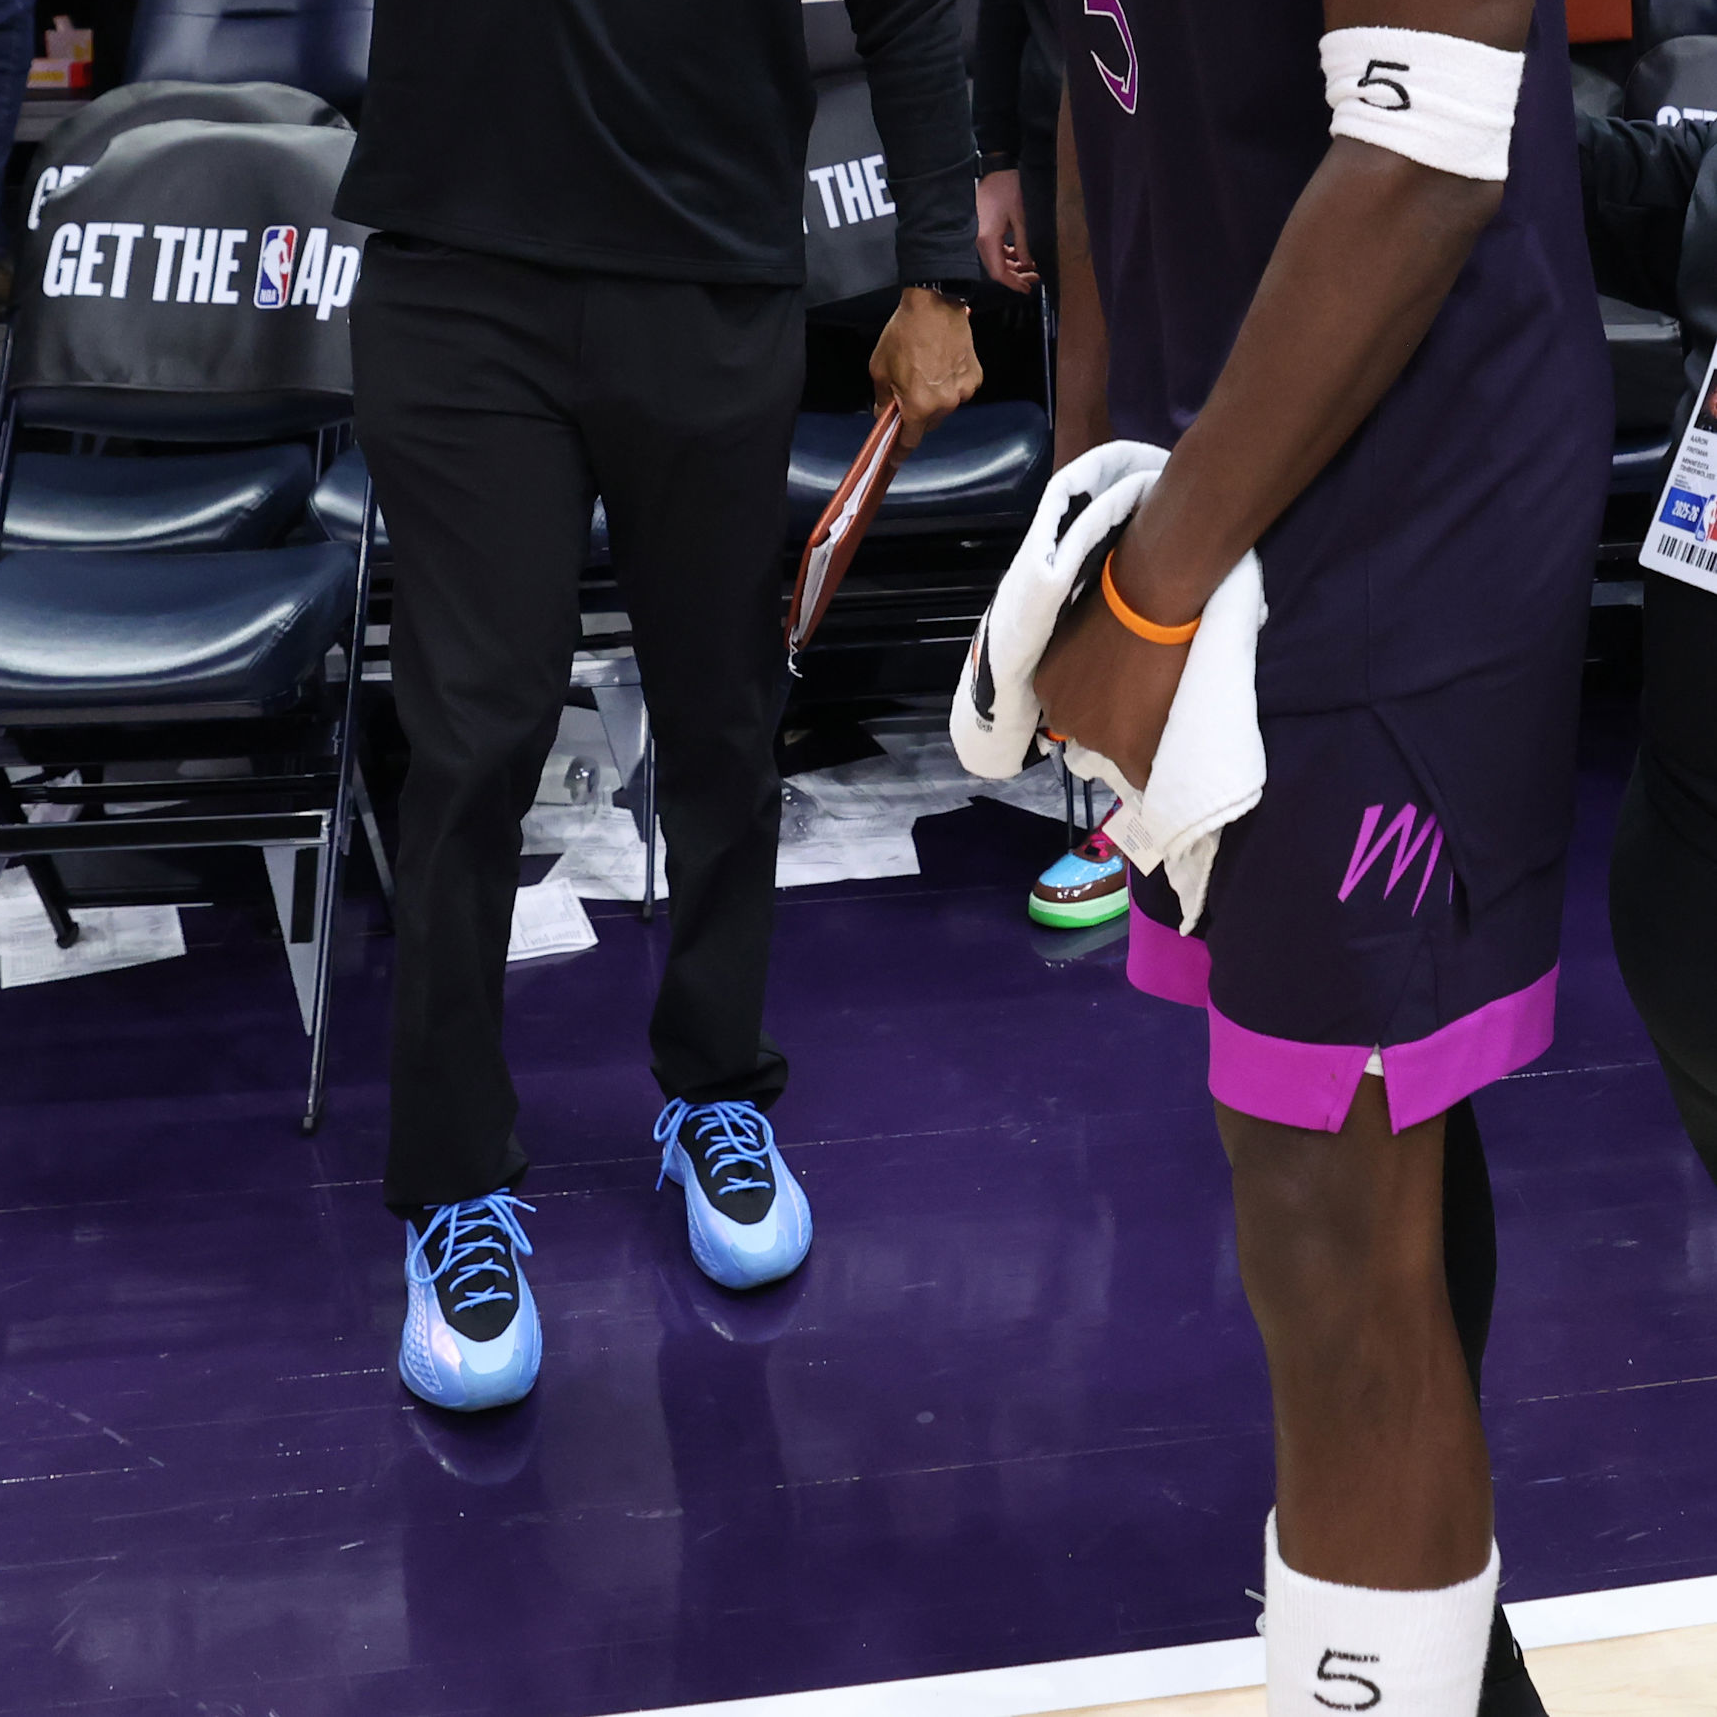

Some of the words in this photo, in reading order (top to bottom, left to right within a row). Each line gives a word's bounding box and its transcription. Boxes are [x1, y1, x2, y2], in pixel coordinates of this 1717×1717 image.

[1358, 59, 1412, 111] 5
[809, 155, 896, 229] THE
[42, 222, 145, 298] GET
[152, 225, 249, 304] THE
[290, 227, 361, 322] Ap
[1315, 1649, 1381, 1711] 5
